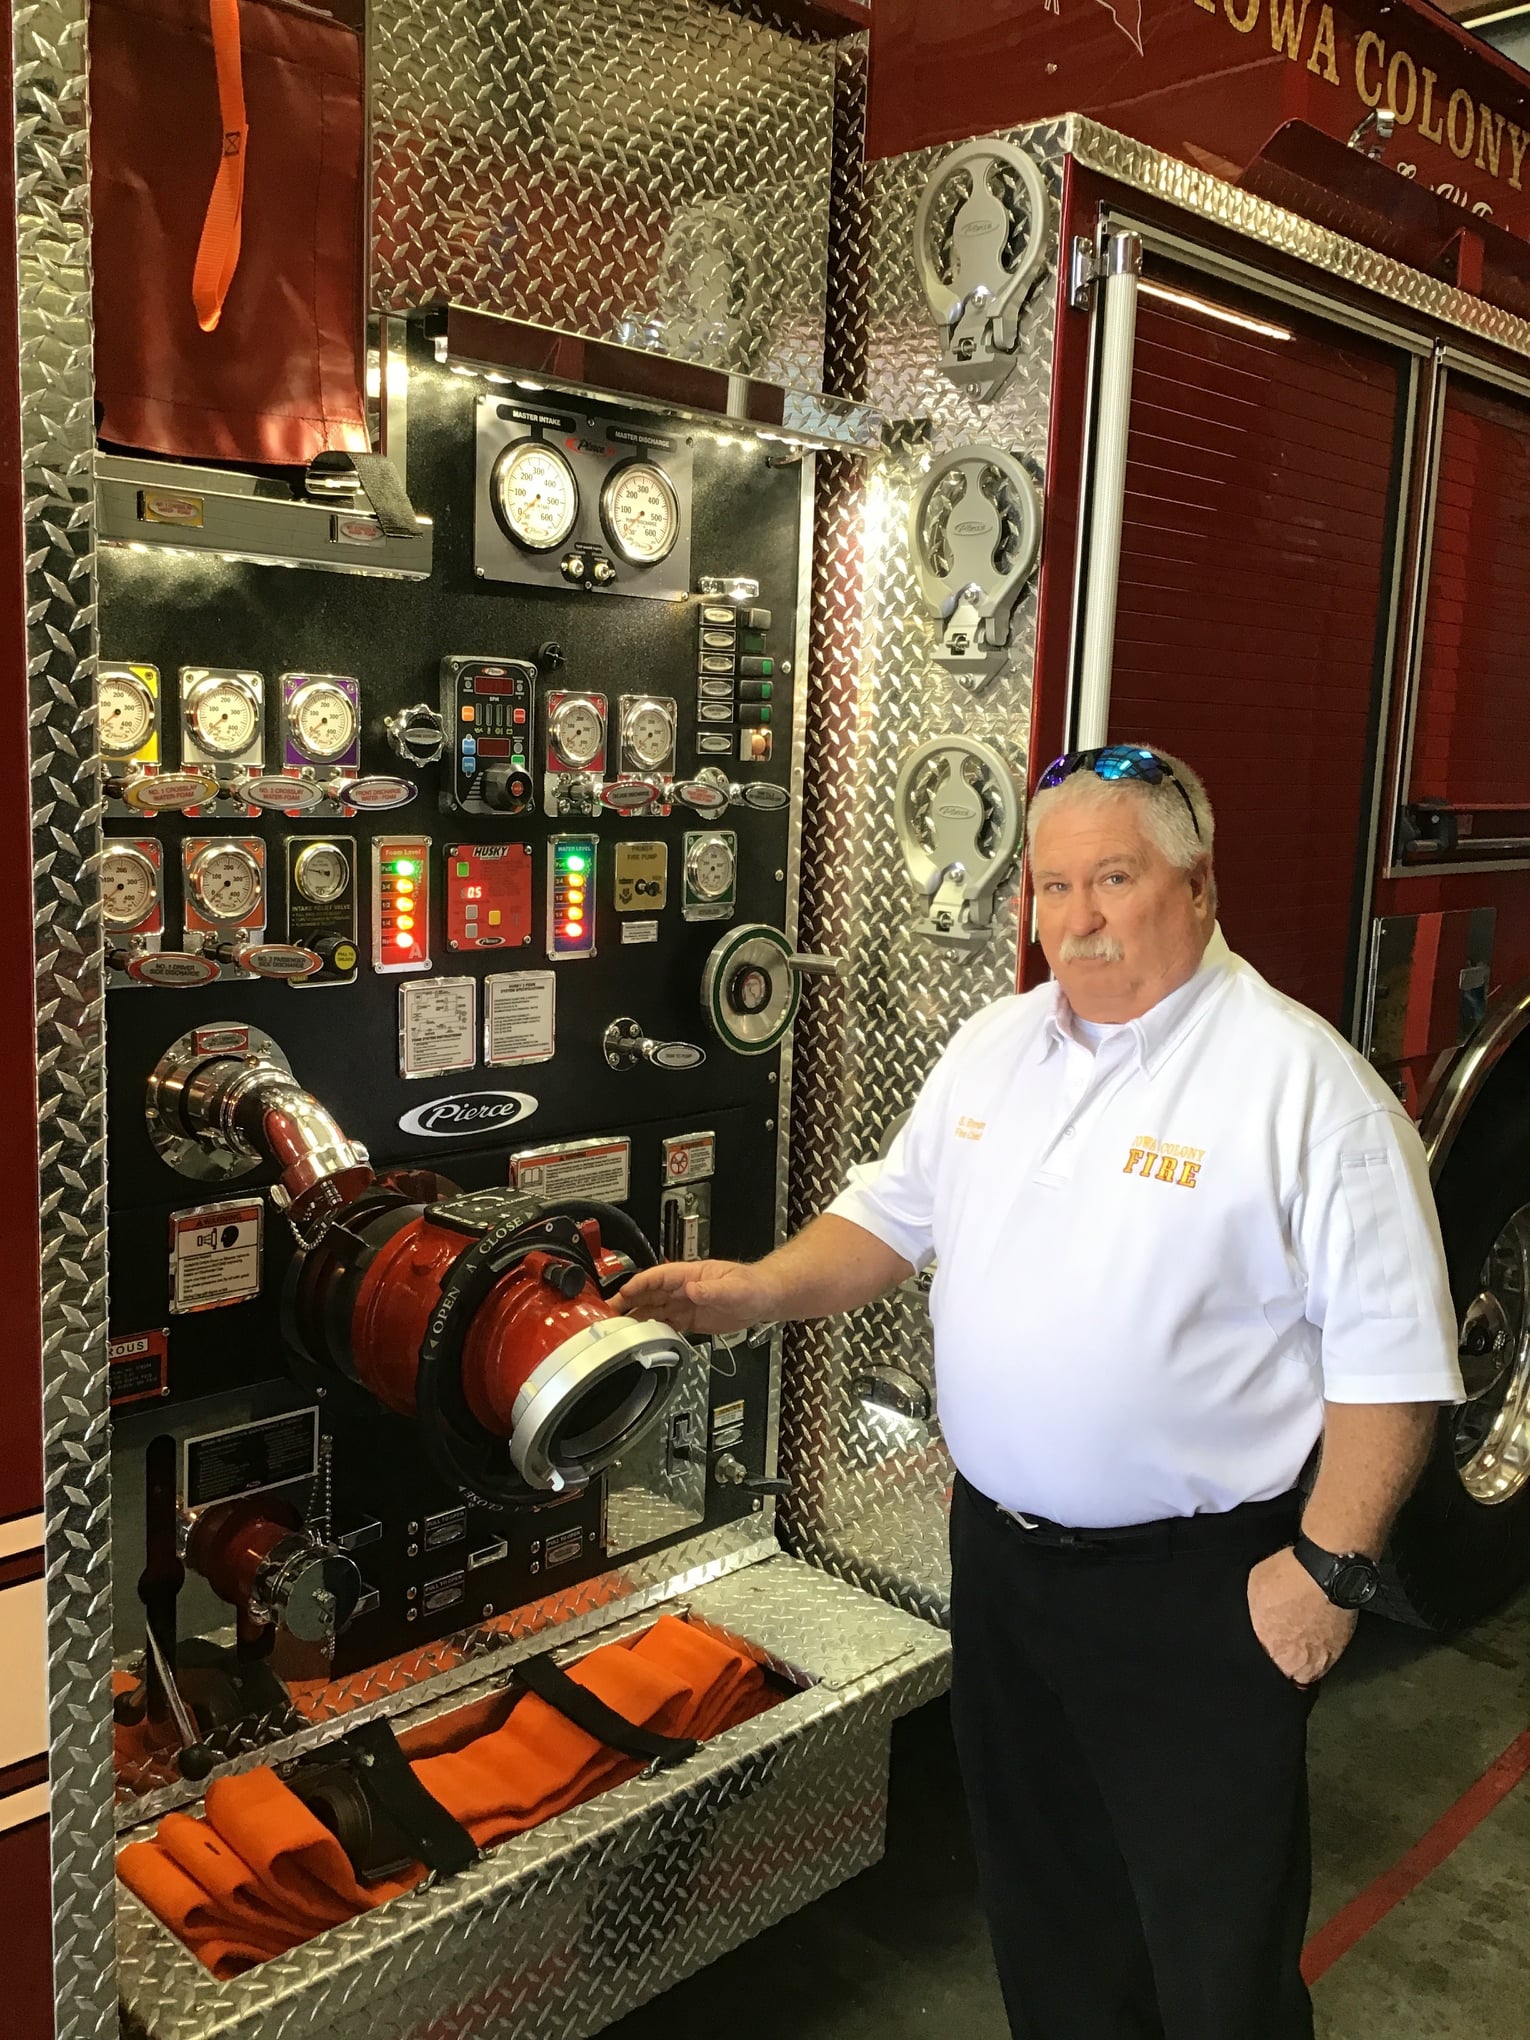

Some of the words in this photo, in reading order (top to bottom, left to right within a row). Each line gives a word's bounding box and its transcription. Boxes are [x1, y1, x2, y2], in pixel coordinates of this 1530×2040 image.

[1194, 0, 1340, 86] WA
[1355, 31, 1530, 191] COLONY
[513, 410, 538, 422] MASTER
[539, 416, 561, 426] INTAKE
[615, 431, 638, 441] MASTER
[639, 435, 670, 448] DISCHARGE
[532, 467, 544, 476] 300
[521, 472, 533, 481] 200
[544, 480, 556, 488] 400
[514, 488, 526, 497] 100
[637, 485, 649, 494] 300
[626, 490, 638, 499] 200
[547, 497, 559, 506] 500
[648, 497, 660, 506] 400
[620, 506, 632, 514] 100
[540, 514, 553, 522] 600
[650, 514, 663, 522] 500
[644, 529, 657, 537] 600
[165, 785, 197, 793] CROSSLAY
[474, 846, 509, 856] HUSKY
[408, 942, 422, 959] A
[426, 1103, 515, 1128] Pierce
[1132, 1136, 1157, 1151] IOWA
[1159, 1143, 1206, 1161] COLONY
[1123, 1148, 1201, 1188] FIRE
[479, 1216, 524, 1254] CLOSE
[432, 1286, 461, 1334] OPEN
[449, 1511, 464, 1520] OPEN
[566, 1531, 580, 1540] OPEN
[447, 1575, 463, 1584] OPEN
